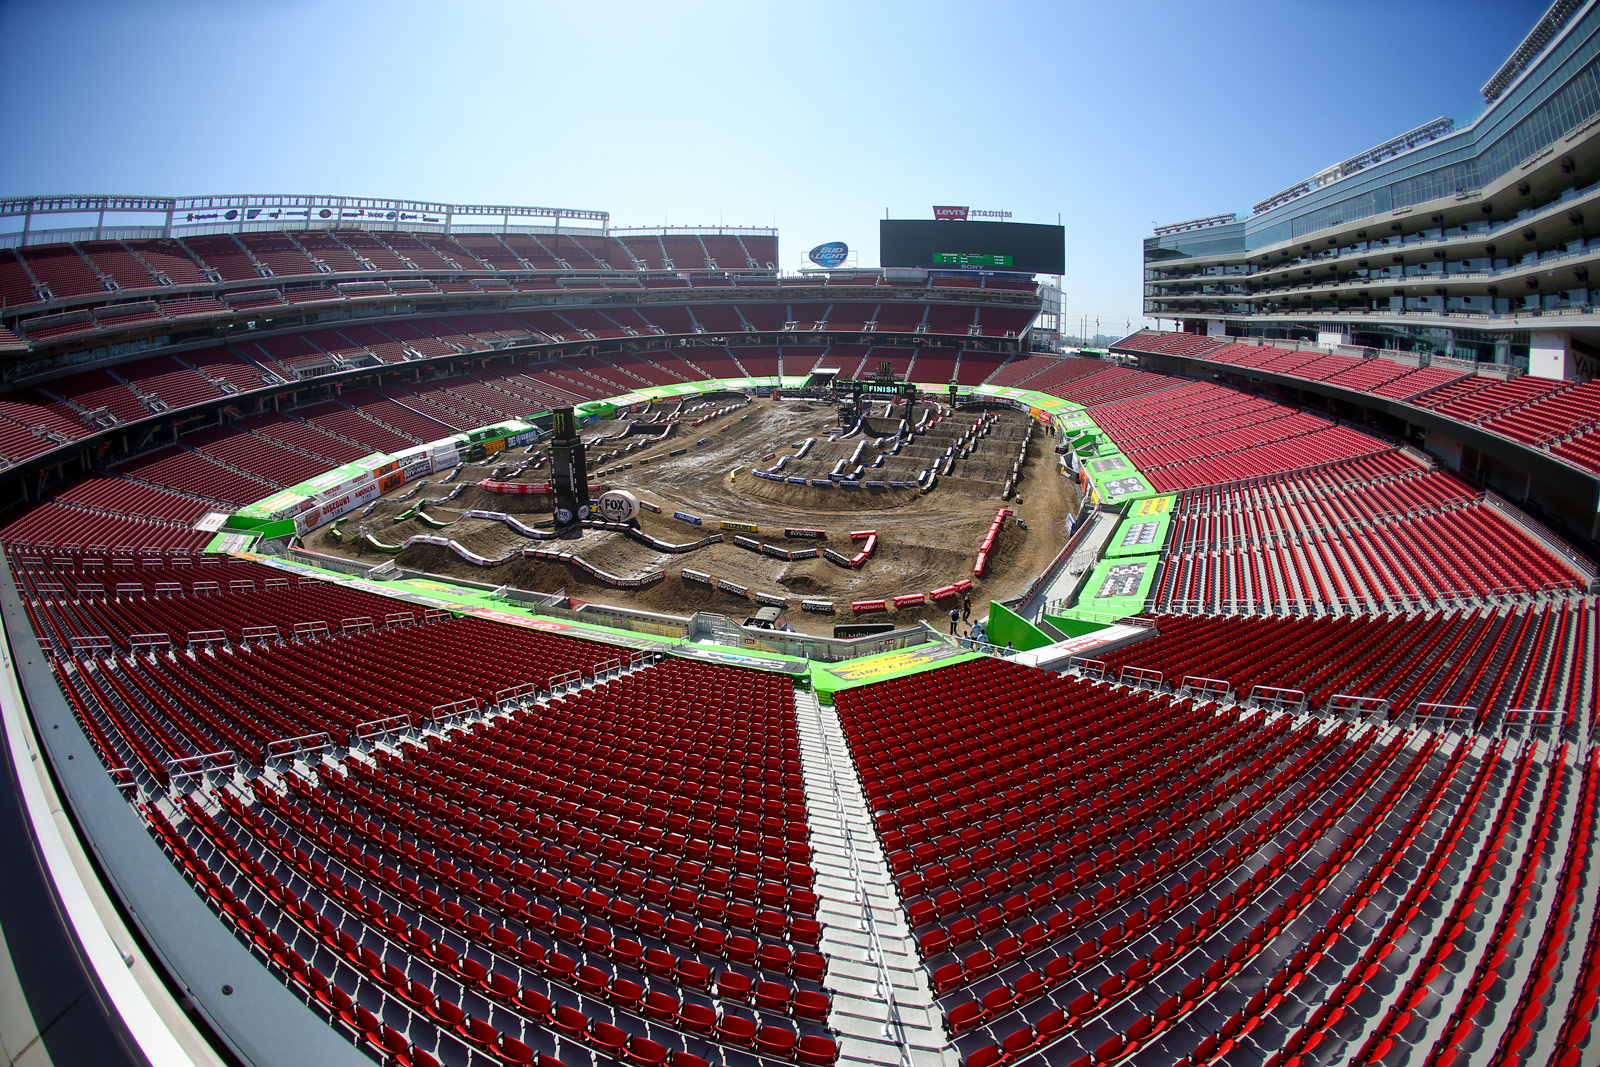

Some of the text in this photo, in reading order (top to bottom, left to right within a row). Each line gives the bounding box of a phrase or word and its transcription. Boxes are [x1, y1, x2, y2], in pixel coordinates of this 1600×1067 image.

[972, 210, 1013, 218] STADIUM
[868, 385, 898, 393] FINISH
[383, 475, 401, 491] KTM
[322, 496, 350, 515] DISCOUNT
[604, 498, 625, 511] FOX
[331, 507, 344, 517] TIRE
[723, 522, 753, 531] SUZUKI
